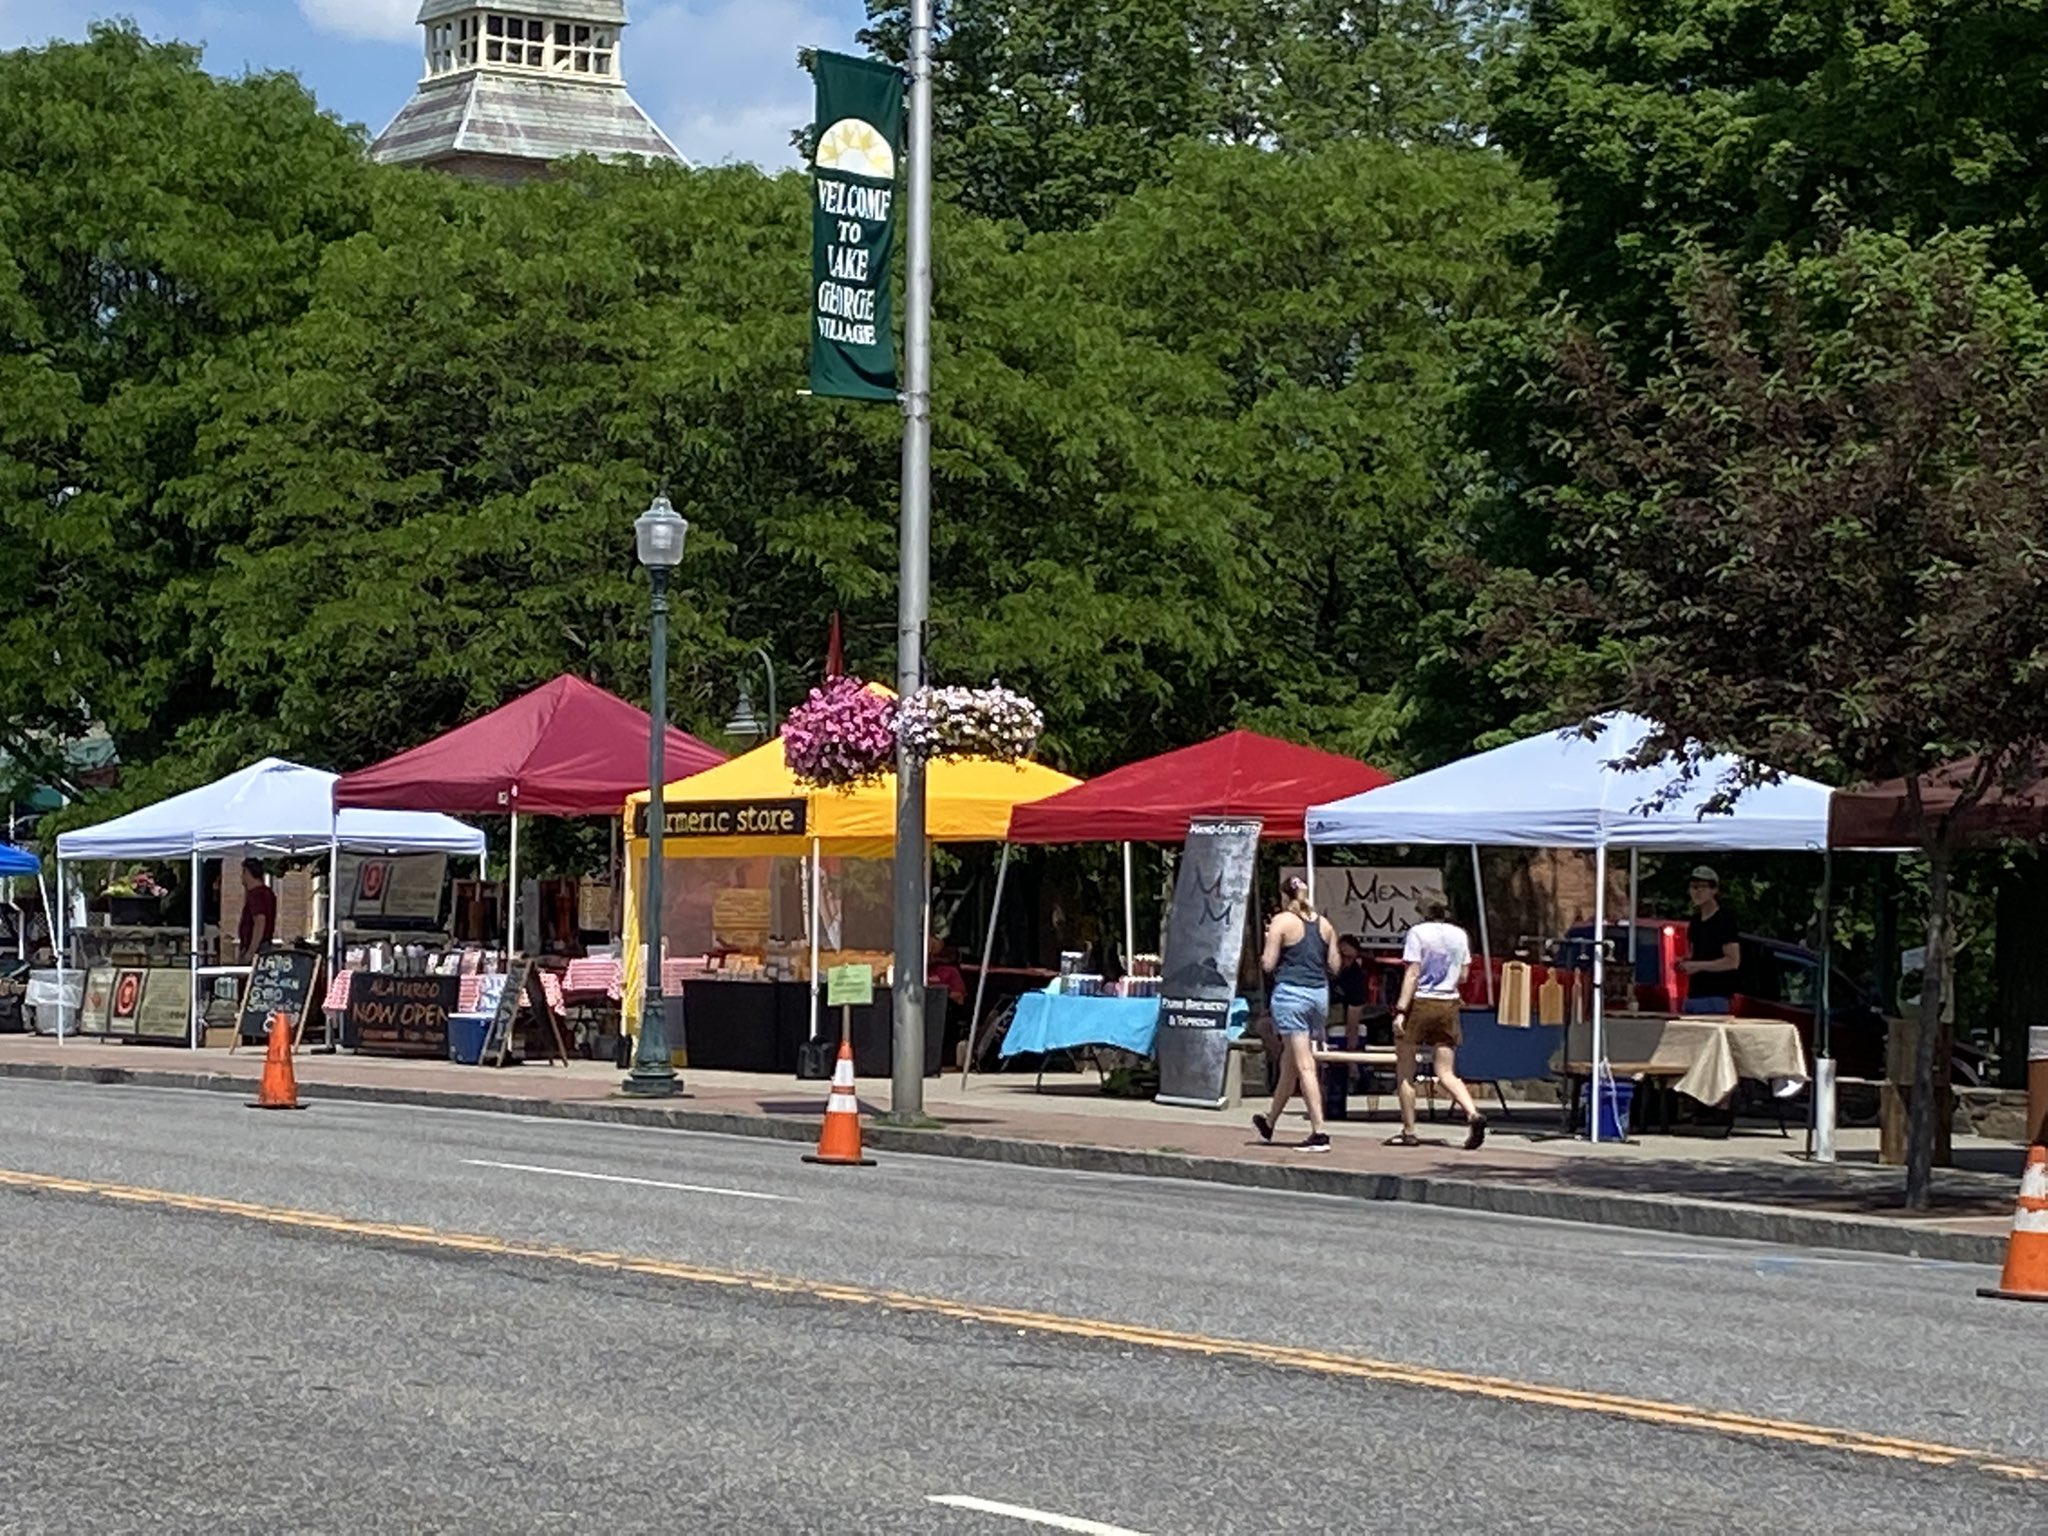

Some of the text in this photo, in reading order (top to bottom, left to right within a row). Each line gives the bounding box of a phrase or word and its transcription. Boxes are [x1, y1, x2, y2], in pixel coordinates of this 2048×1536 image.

[837, 219, 862, 243] TO
[828, 245, 868, 281] LAKE
[818, 280, 876, 322] GEORGE
[818, 317, 876, 345] VILLAGE
[737, 806, 795, 831] store
[1361, 903, 1412, 933] MA
[352, 1002, 452, 1026] NOW OPEN
